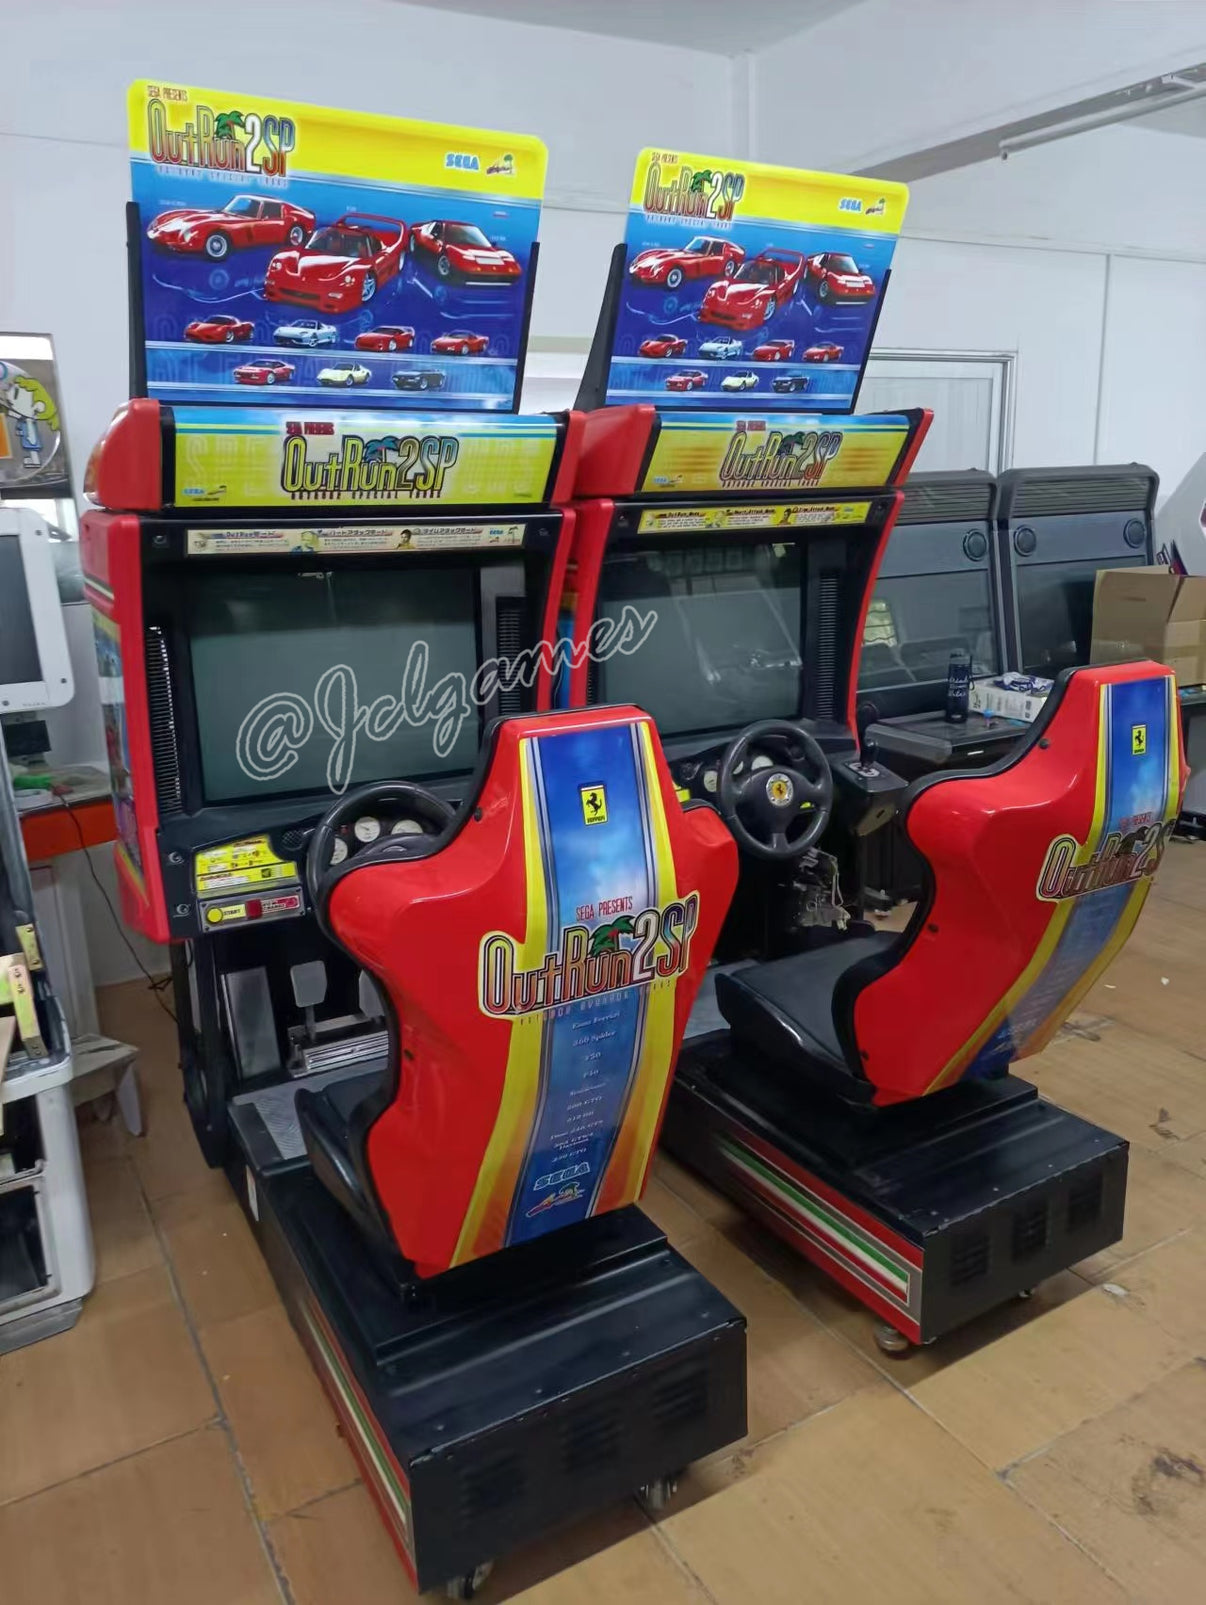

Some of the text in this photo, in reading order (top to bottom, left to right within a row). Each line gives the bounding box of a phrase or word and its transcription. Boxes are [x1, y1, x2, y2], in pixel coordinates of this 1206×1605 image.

[446, 153, 479, 170] SEGA
[576, 895, 634, 922] SEGA PRESENTS
